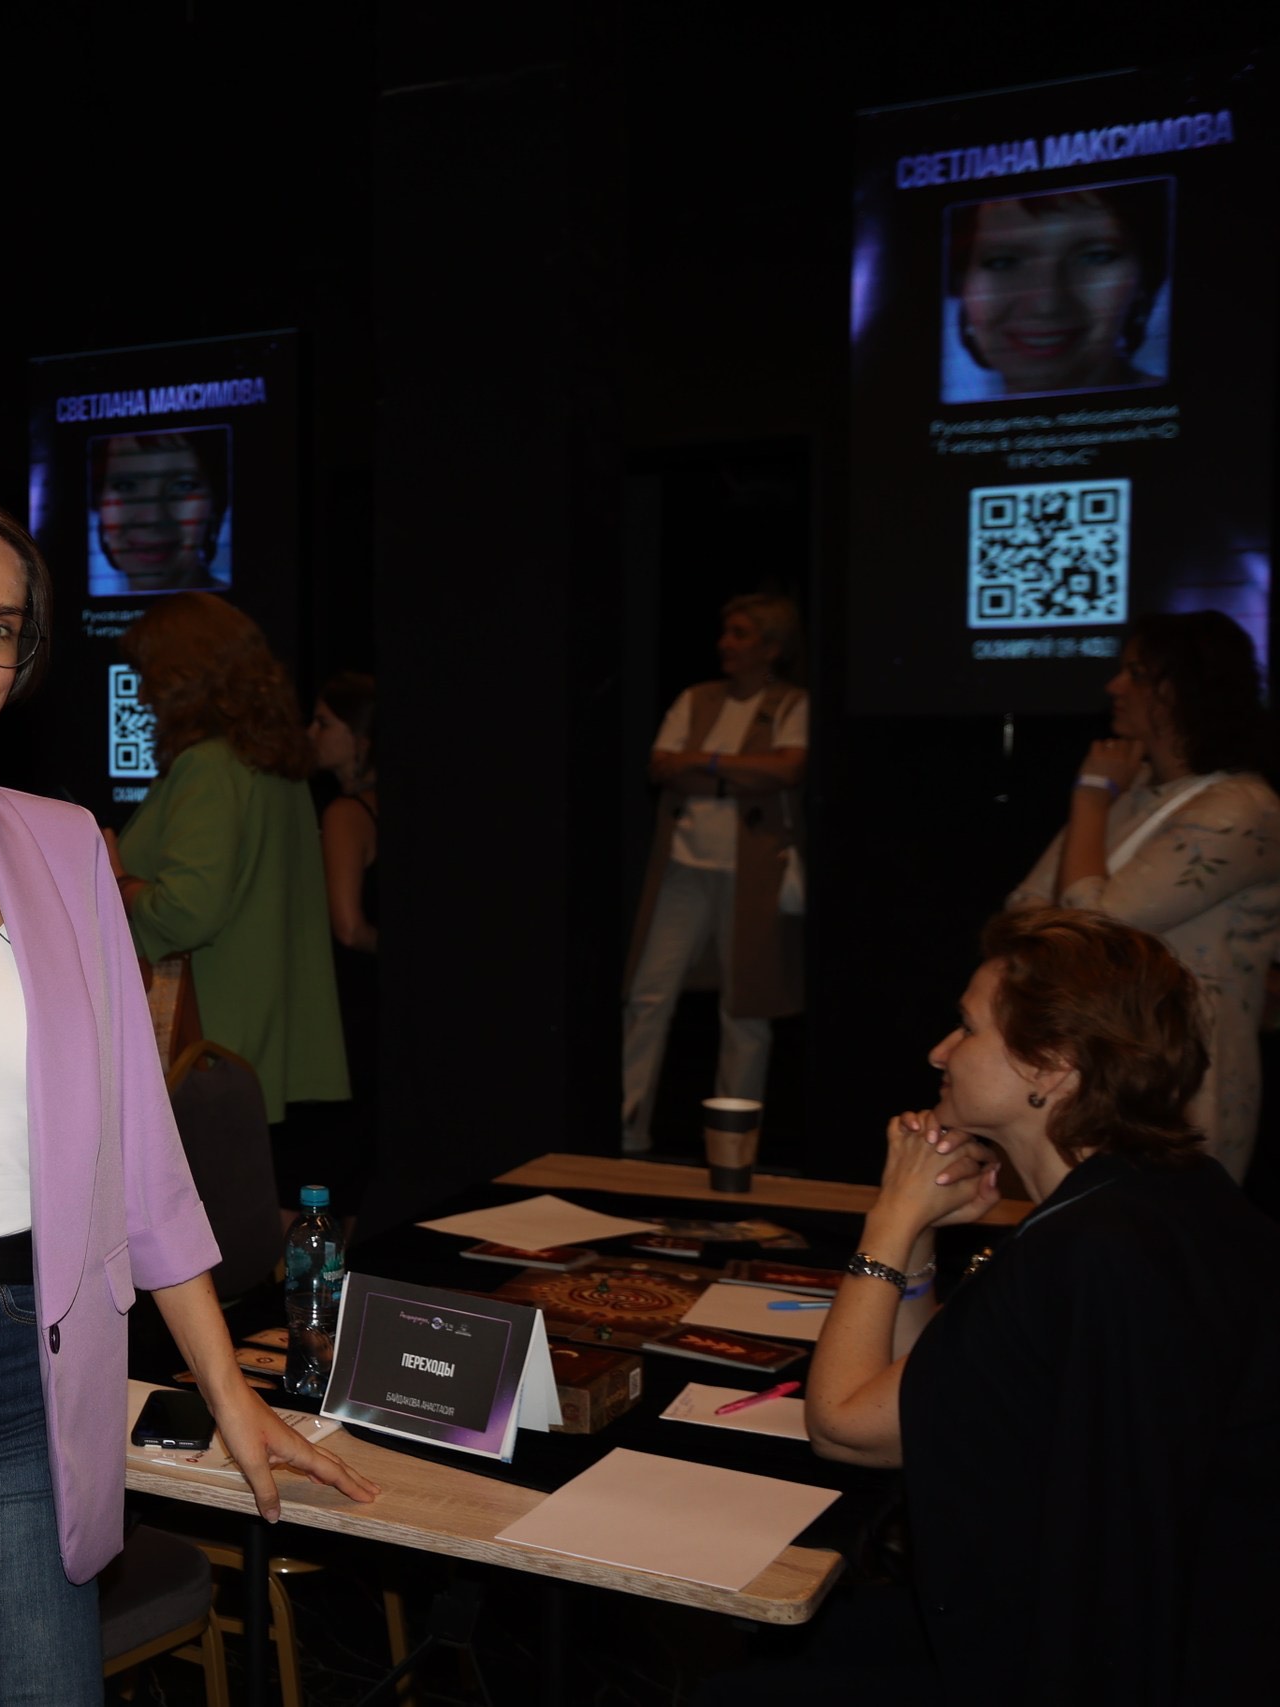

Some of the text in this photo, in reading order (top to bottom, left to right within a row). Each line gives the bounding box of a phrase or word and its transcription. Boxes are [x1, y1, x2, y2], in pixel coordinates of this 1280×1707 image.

[896, 108, 1234, 190] СВЕТЛАНА МАКСИМОВА
[56, 376, 266, 424] СВЕТЛАНА МАКСИМОВА
[401, 1353, 456, 1377] ПЕРЕХОДЫ
[385, 1391, 455, 1416] БАЙДАКОВА АНАСТАСИЯ
